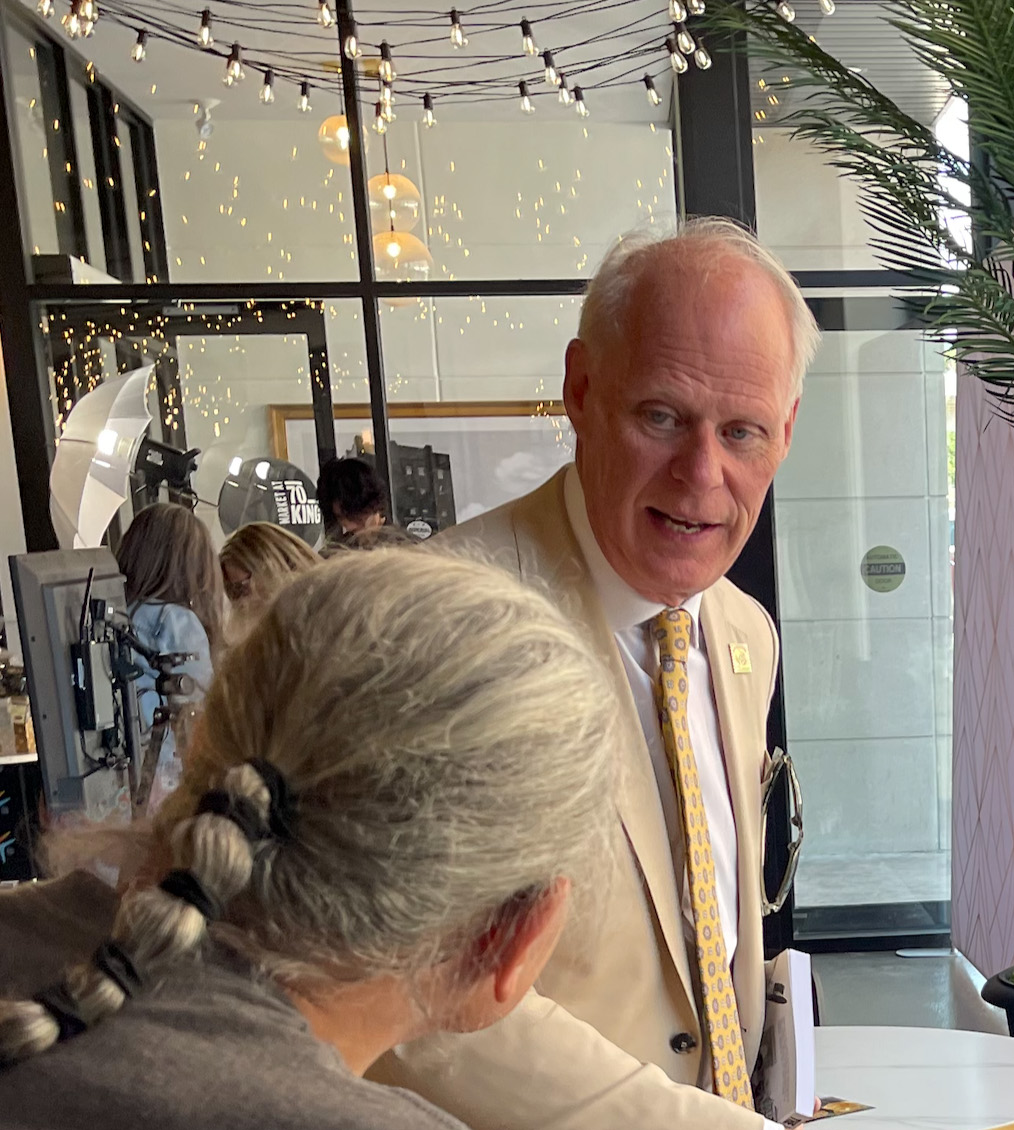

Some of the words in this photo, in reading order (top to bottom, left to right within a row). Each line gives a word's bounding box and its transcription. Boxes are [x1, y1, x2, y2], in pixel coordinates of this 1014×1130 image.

[271, 481, 285, 490] AT
[285, 485, 307, 504] 70
[273, 491, 291, 524] MARKET
[290, 504, 321, 524] KING
